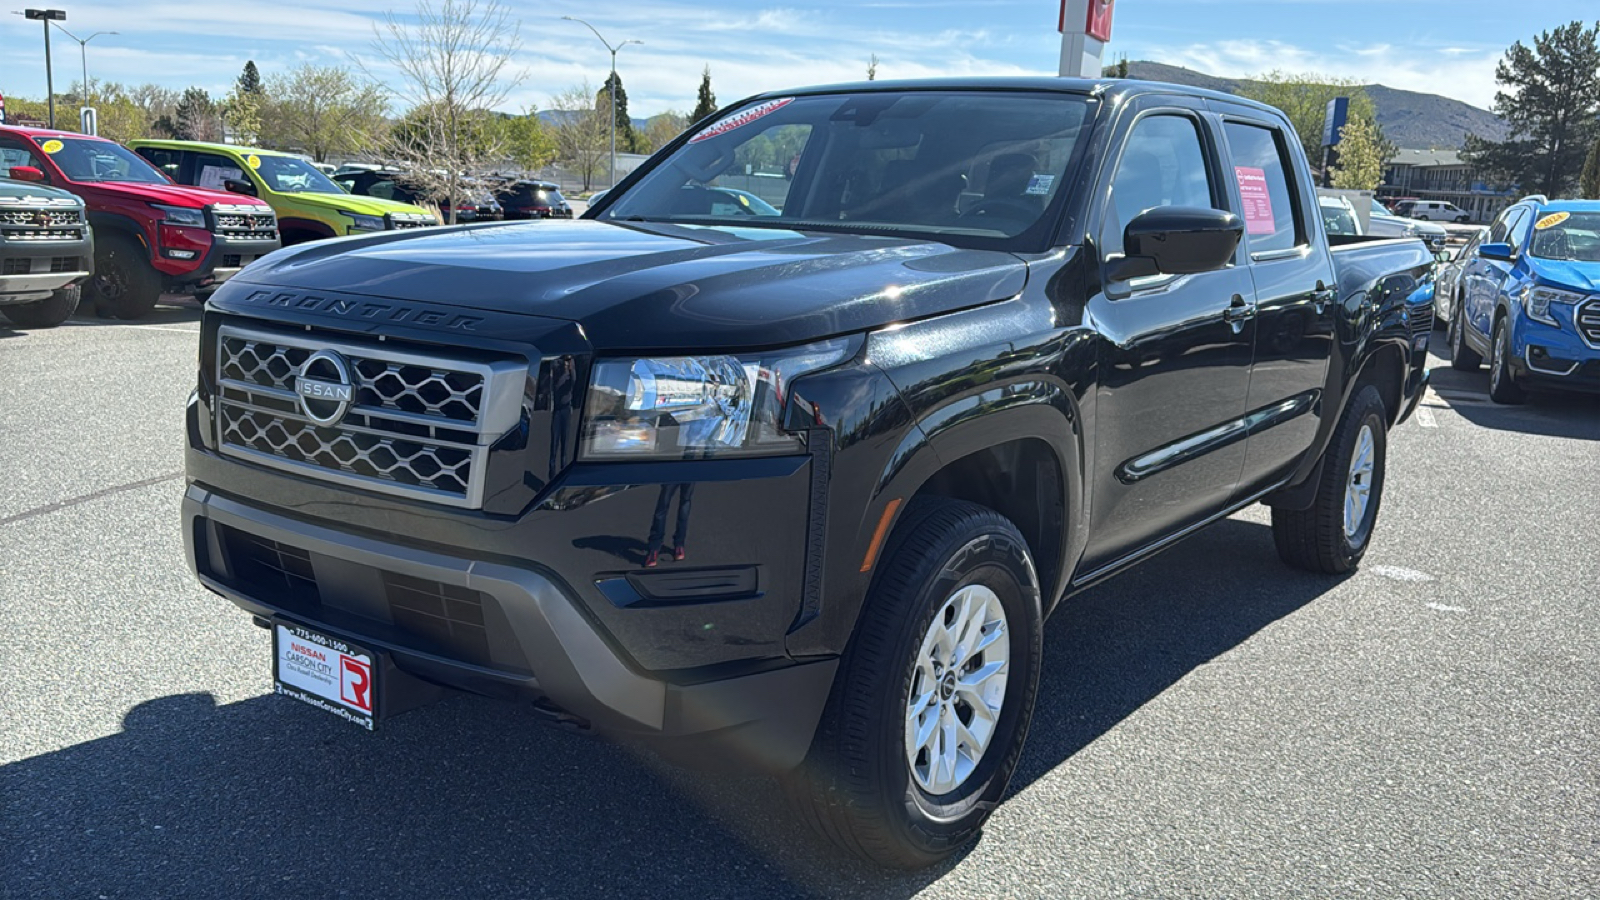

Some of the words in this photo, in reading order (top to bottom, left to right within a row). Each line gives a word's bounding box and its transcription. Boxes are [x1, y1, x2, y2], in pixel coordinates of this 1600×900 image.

[245, 290, 486, 330] FRONTIER
[291, 642, 326, 661] NISSAN
[296, 627, 348, 652] 775-600-1500
[285, 651, 316, 668] CARSON
[317, 662, 332, 675] CITY
